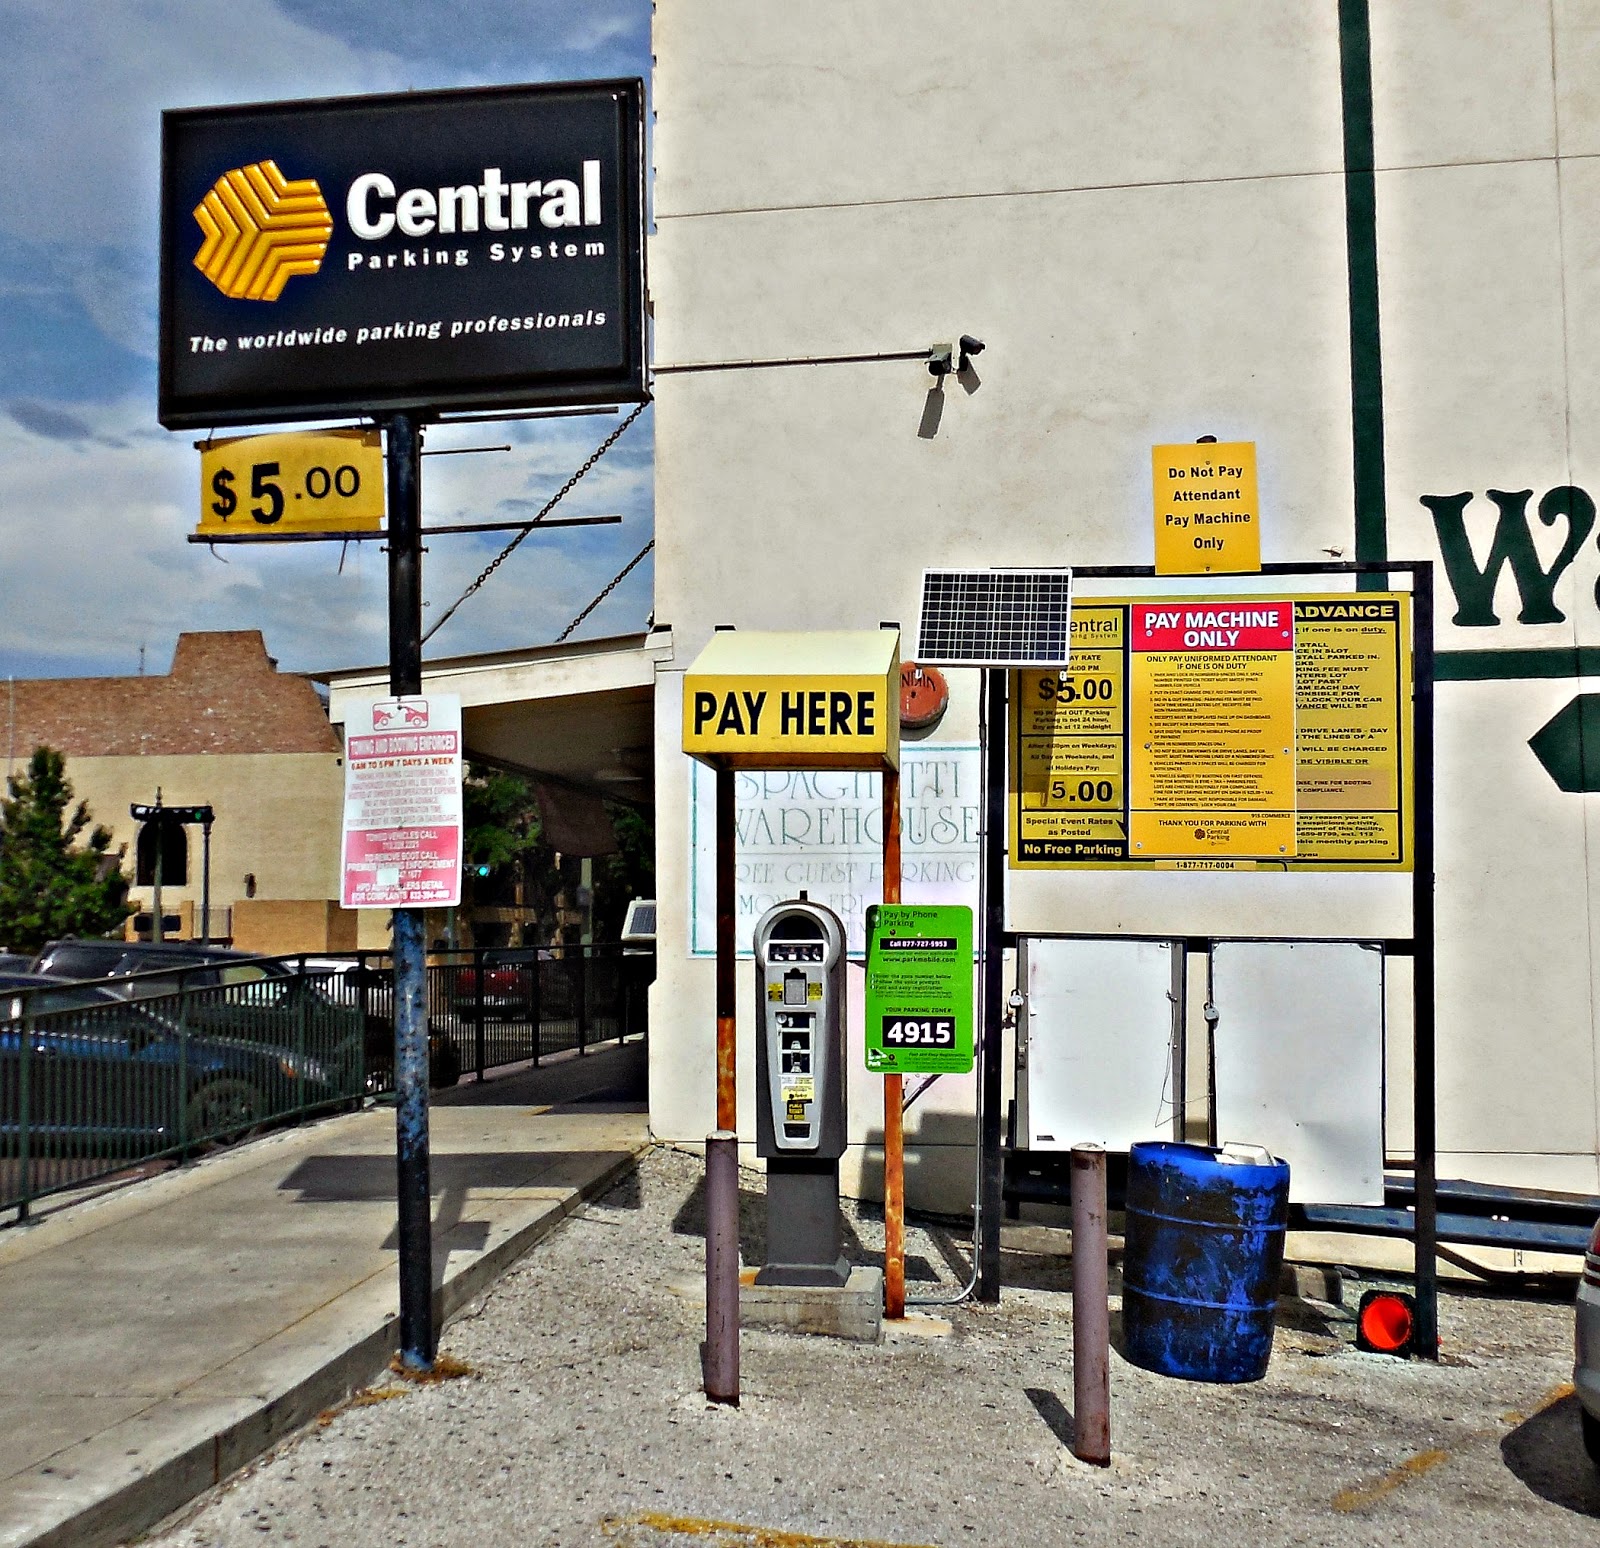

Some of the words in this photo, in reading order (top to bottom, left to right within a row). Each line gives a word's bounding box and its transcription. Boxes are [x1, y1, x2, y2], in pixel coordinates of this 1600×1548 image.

[346, 160, 602, 240] Central
[348, 248, 468, 271] Parking
[490, 241, 604, 262] System
[190, 335, 227, 353] The
[237, 326, 347, 350] worldwide
[356, 321, 442, 343] parking
[450, 309, 606, 336] professionals
[1169, 468, 1185, 478] Do
[1190, 467, 1213, 477] Not
[1219, 466, 1243, 478] Pay
[1173, 489, 1240, 501] Attendant
[1165, 514, 1189, 528] Pay
[1194, 512, 1250, 524] Machine
[1194, 537, 1224, 550] Only
[1295, 606, 1394, 618] ADVANCE
[1070, 618, 1118, 632] entral
[1145, 612, 1181, 629] PAY
[1185, 611, 1279, 628] MACHINE
[1183, 630, 1240, 647] ONLY
[1146, 655, 1167, 663] ONLY
[1039, 677, 1113, 703] $5.00
[694, 691, 767, 736] PAY
[781, 691, 875, 736] HERE
[432, 757, 454, 765] WEEK
[1052, 781, 1113, 802] 5.00
[1026, 818, 1058, 826] Special
[1024, 844, 1041, 854] No
[1044, 844, 1071, 854] Free
[1075, 844, 1122, 856] Parking
[884, 911, 898, 919] Pay
[901, 911, 910, 919] by
[912, 910, 937, 918] Phone
[884, 920, 914, 928] Parking
[887, 1022, 950, 1043] 4915
